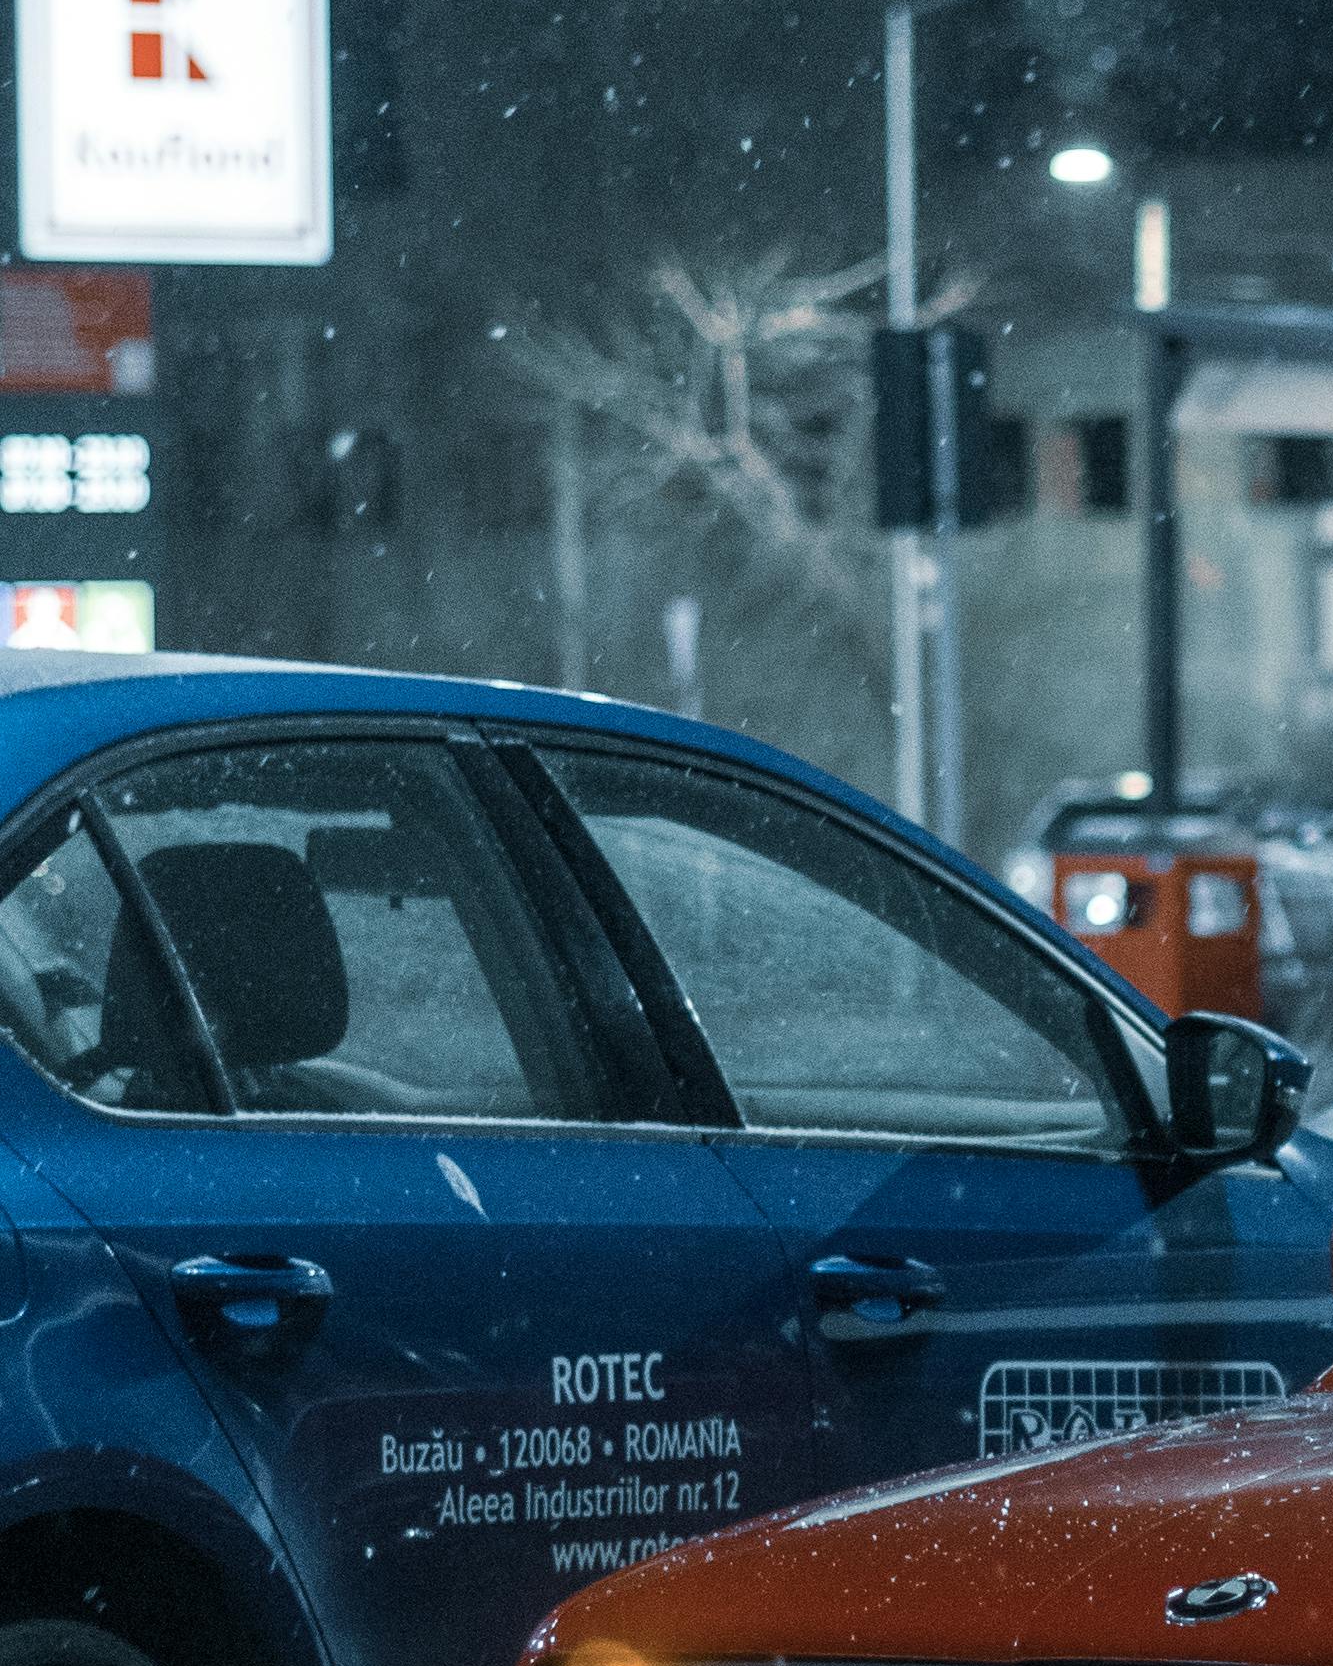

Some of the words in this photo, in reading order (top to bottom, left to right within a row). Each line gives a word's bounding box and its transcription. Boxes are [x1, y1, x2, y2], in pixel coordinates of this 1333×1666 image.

[552, 1352, 666, 1405] ROTEC
[381, 1429, 463, 1474] Buzău
[499, 1426, 592, 1469] 120068
[624, 1418, 742, 1463] ROMANIA
[438, 1483, 515, 1527] Aleea
[525, 1476, 669, 1521] Industriilor
